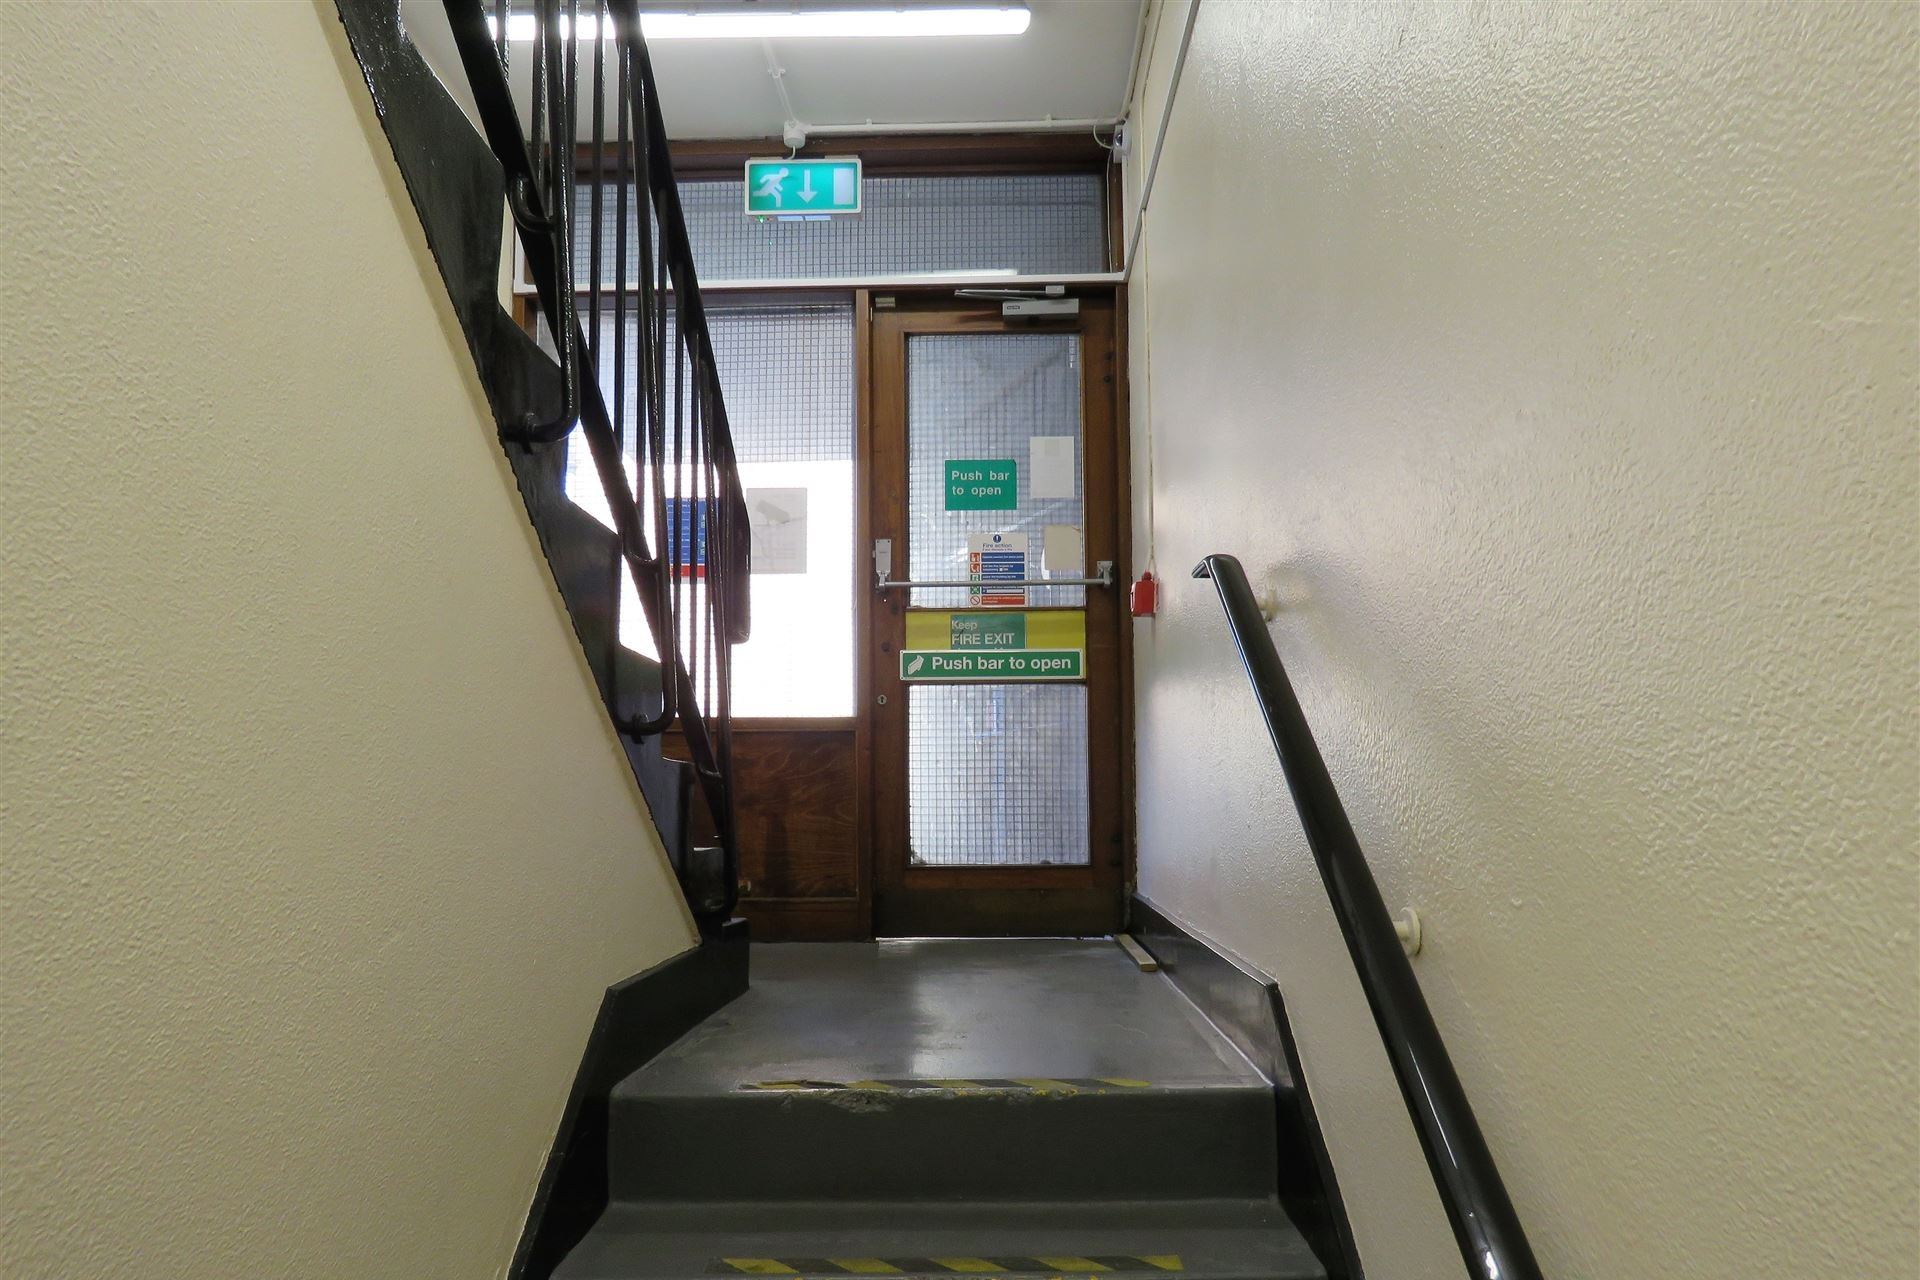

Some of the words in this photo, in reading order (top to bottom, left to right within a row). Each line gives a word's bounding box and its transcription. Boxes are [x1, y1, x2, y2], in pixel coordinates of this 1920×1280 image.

[951, 470, 983, 481] Push
[989, 470, 1010, 481] bar
[952, 486, 964, 496] to
[971, 486, 1002, 498] open
[951, 620, 978, 631] Keep
[951, 633, 981, 646] FIRE
[984, 632, 1016, 645] EXIT
[931, 656, 973, 670] Push
[977, 656, 1005, 670] bar
[1009, 657, 1026, 670] to
[1030, 657, 1072, 672] open
